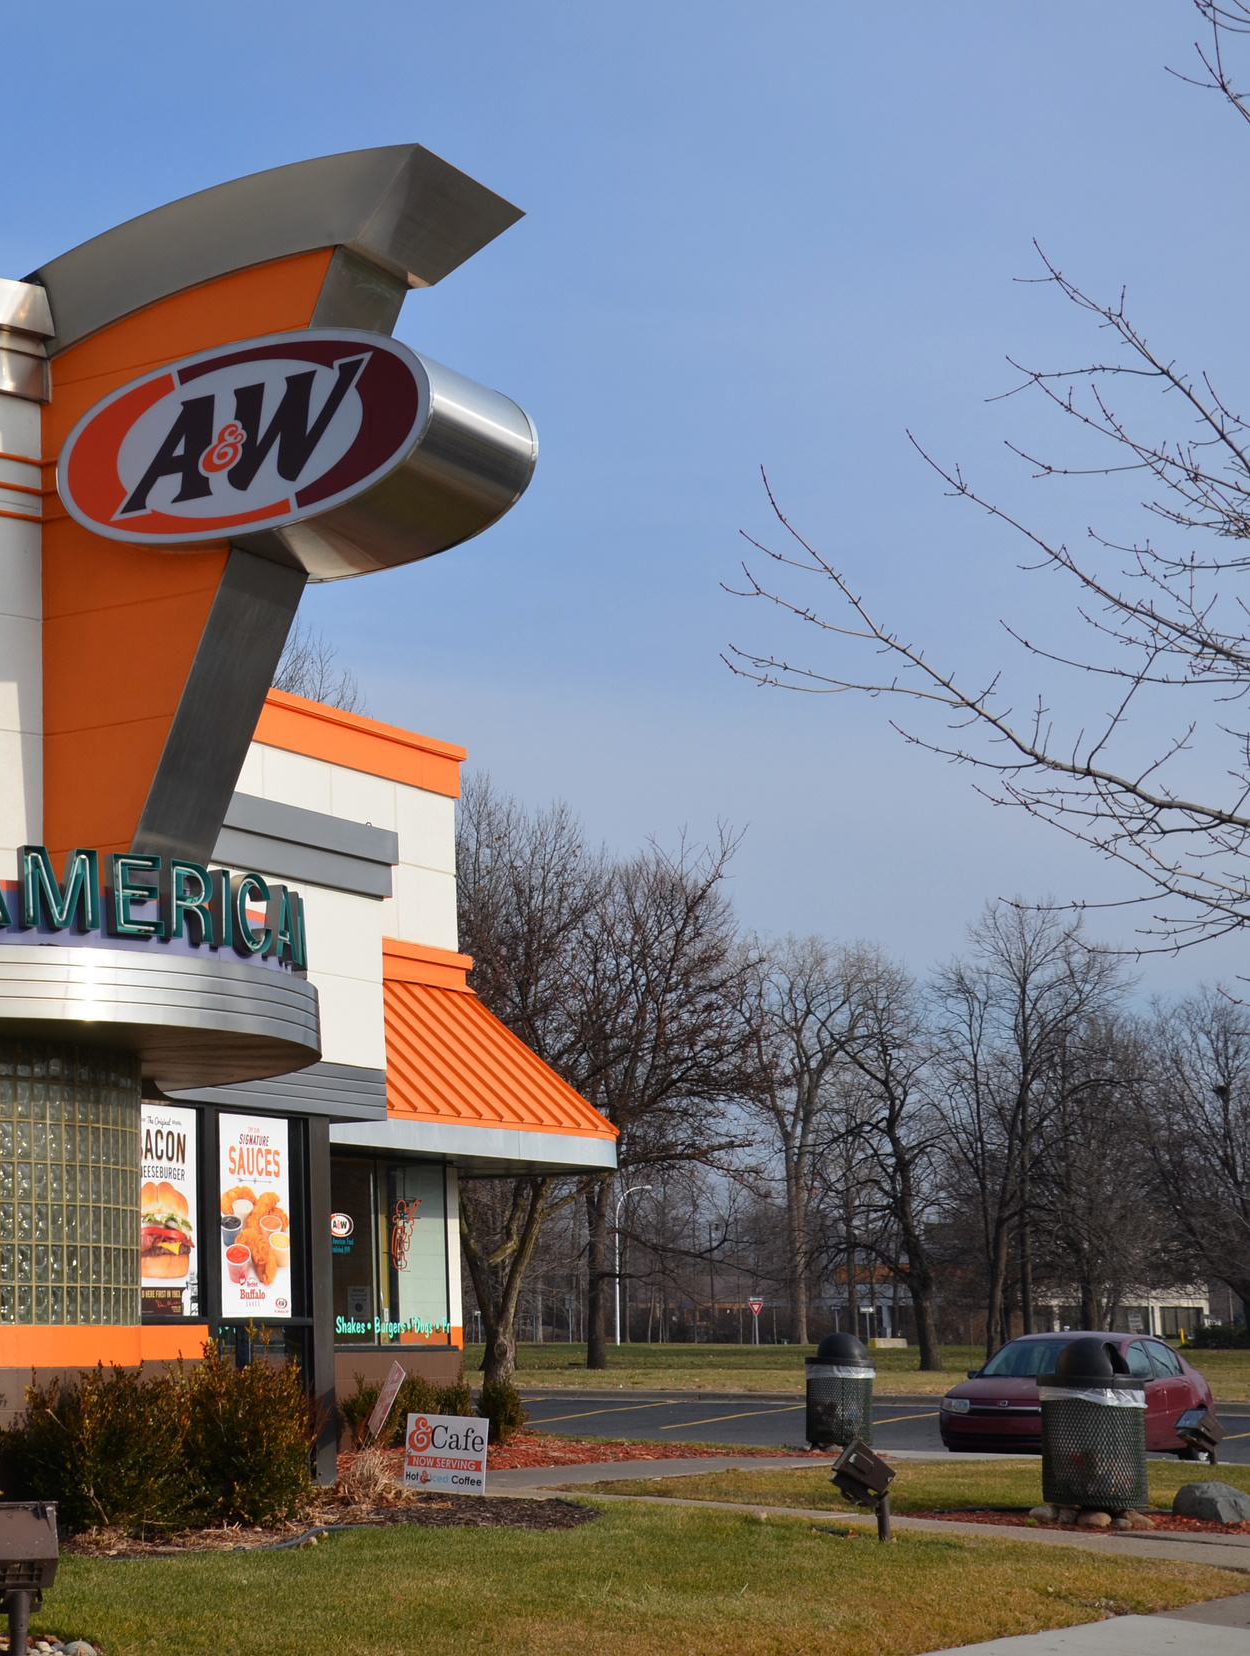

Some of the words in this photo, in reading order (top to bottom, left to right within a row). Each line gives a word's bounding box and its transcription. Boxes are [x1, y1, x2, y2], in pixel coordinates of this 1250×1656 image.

[119, 357, 367, 514] A&W
[141, 1129, 186, 1165] ACON
[239, 1133, 269, 1146] SIGNATURE
[229, 1145, 280, 1178] SAUCES
[240, 1288, 266, 1300] Buffalo
[335, 1315, 366, 1334] Shakes
[374, 1316, 407, 1339] Burgers
[414, 1316, 433, 1339] Dogs
[412, 1456, 435, 1467] NOW
[436, 1458, 476, 1471] SERVING
[405, 1471, 419, 1481] Hot
[451, 1474, 482, 1487] Coffee
